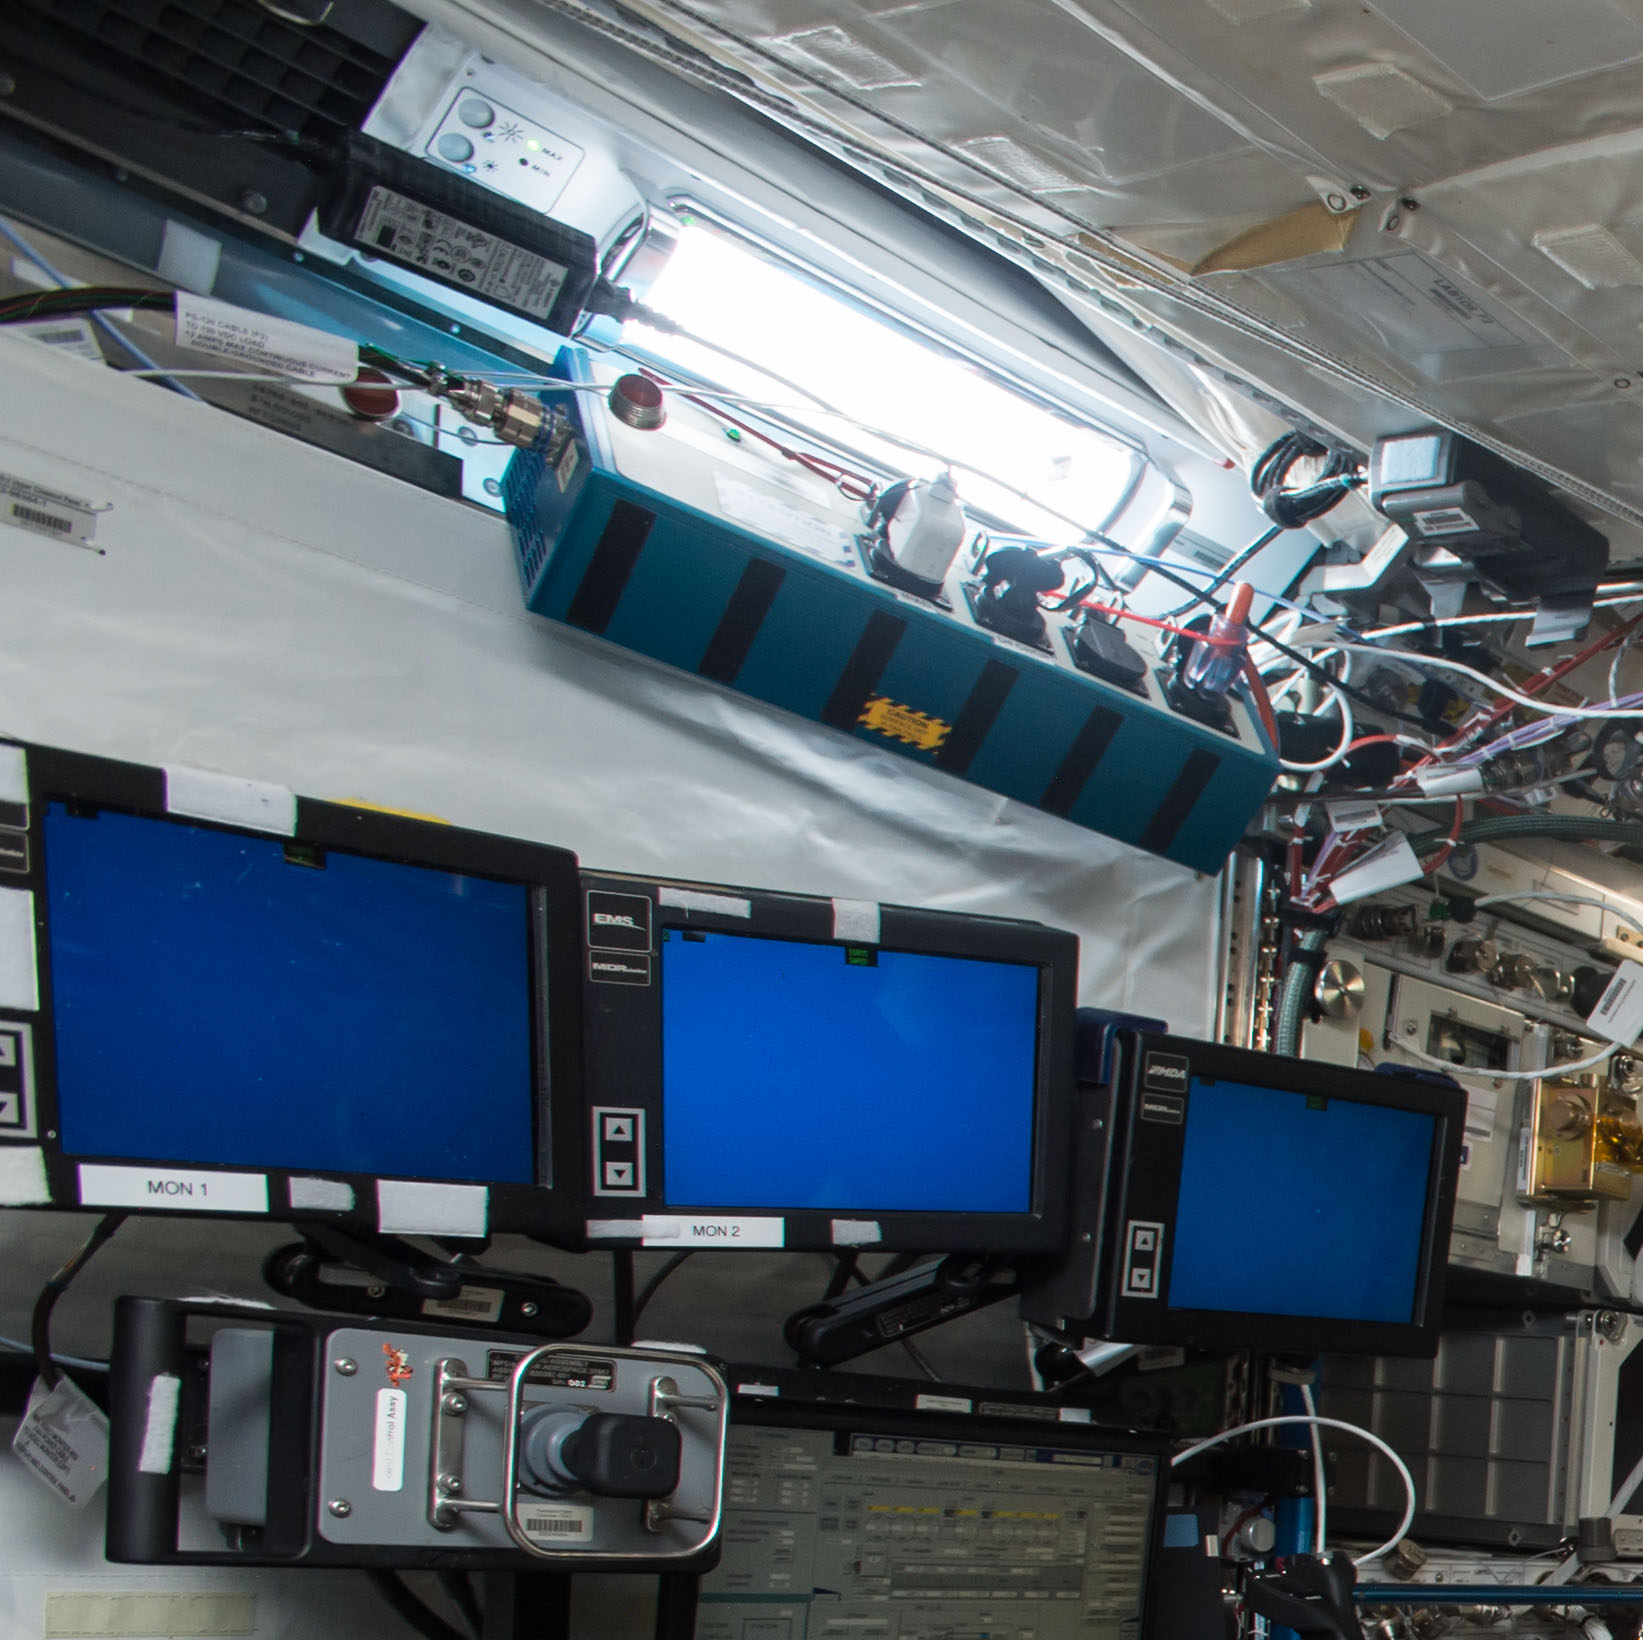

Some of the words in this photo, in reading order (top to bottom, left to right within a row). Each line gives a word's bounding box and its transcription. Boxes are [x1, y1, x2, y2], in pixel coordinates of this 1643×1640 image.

[593, 913, 635, 930] EMS
[147, 1180, 193, 1197] MON
[692, 1225, 724, 1237] MON
[731, 1225, 741, 1237] 2
